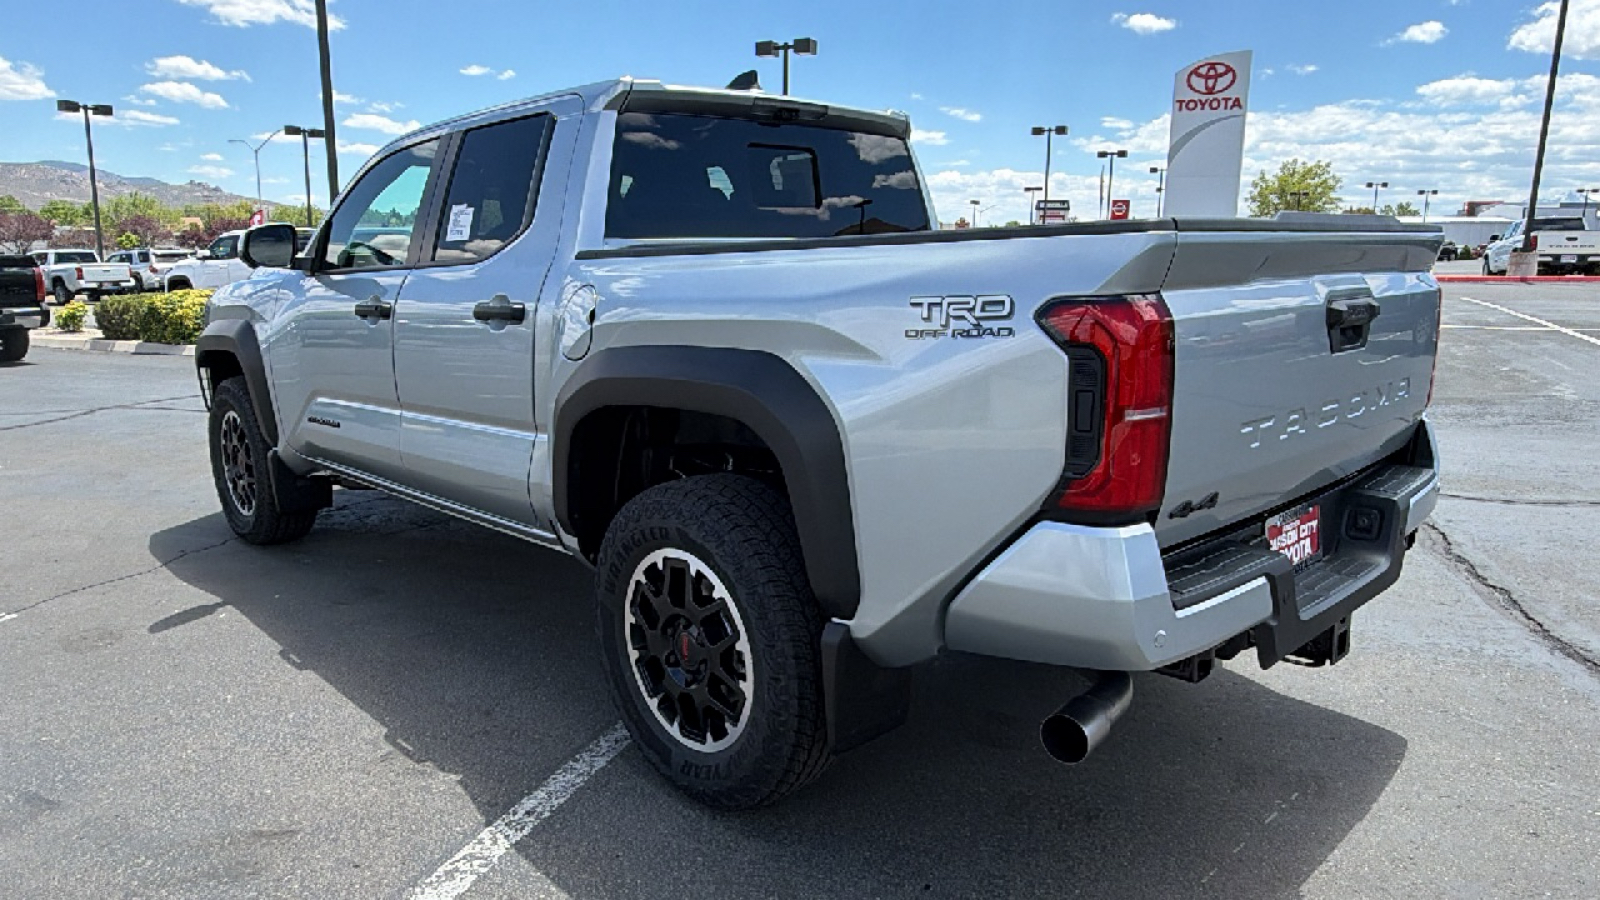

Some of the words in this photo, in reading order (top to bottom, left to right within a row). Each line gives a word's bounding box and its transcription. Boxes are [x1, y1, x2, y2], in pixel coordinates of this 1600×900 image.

[1175, 96, 1243, 112] TOYOTA
[909, 294, 1015, 328] TRD
[904, 328, 947, 339] OFF
[951, 327, 1015, 339] ROAD
[1240, 376, 1411, 449] TACOMA
[1299, 519, 1319, 538] CITY
[1279, 537, 1312, 566] YOTA
